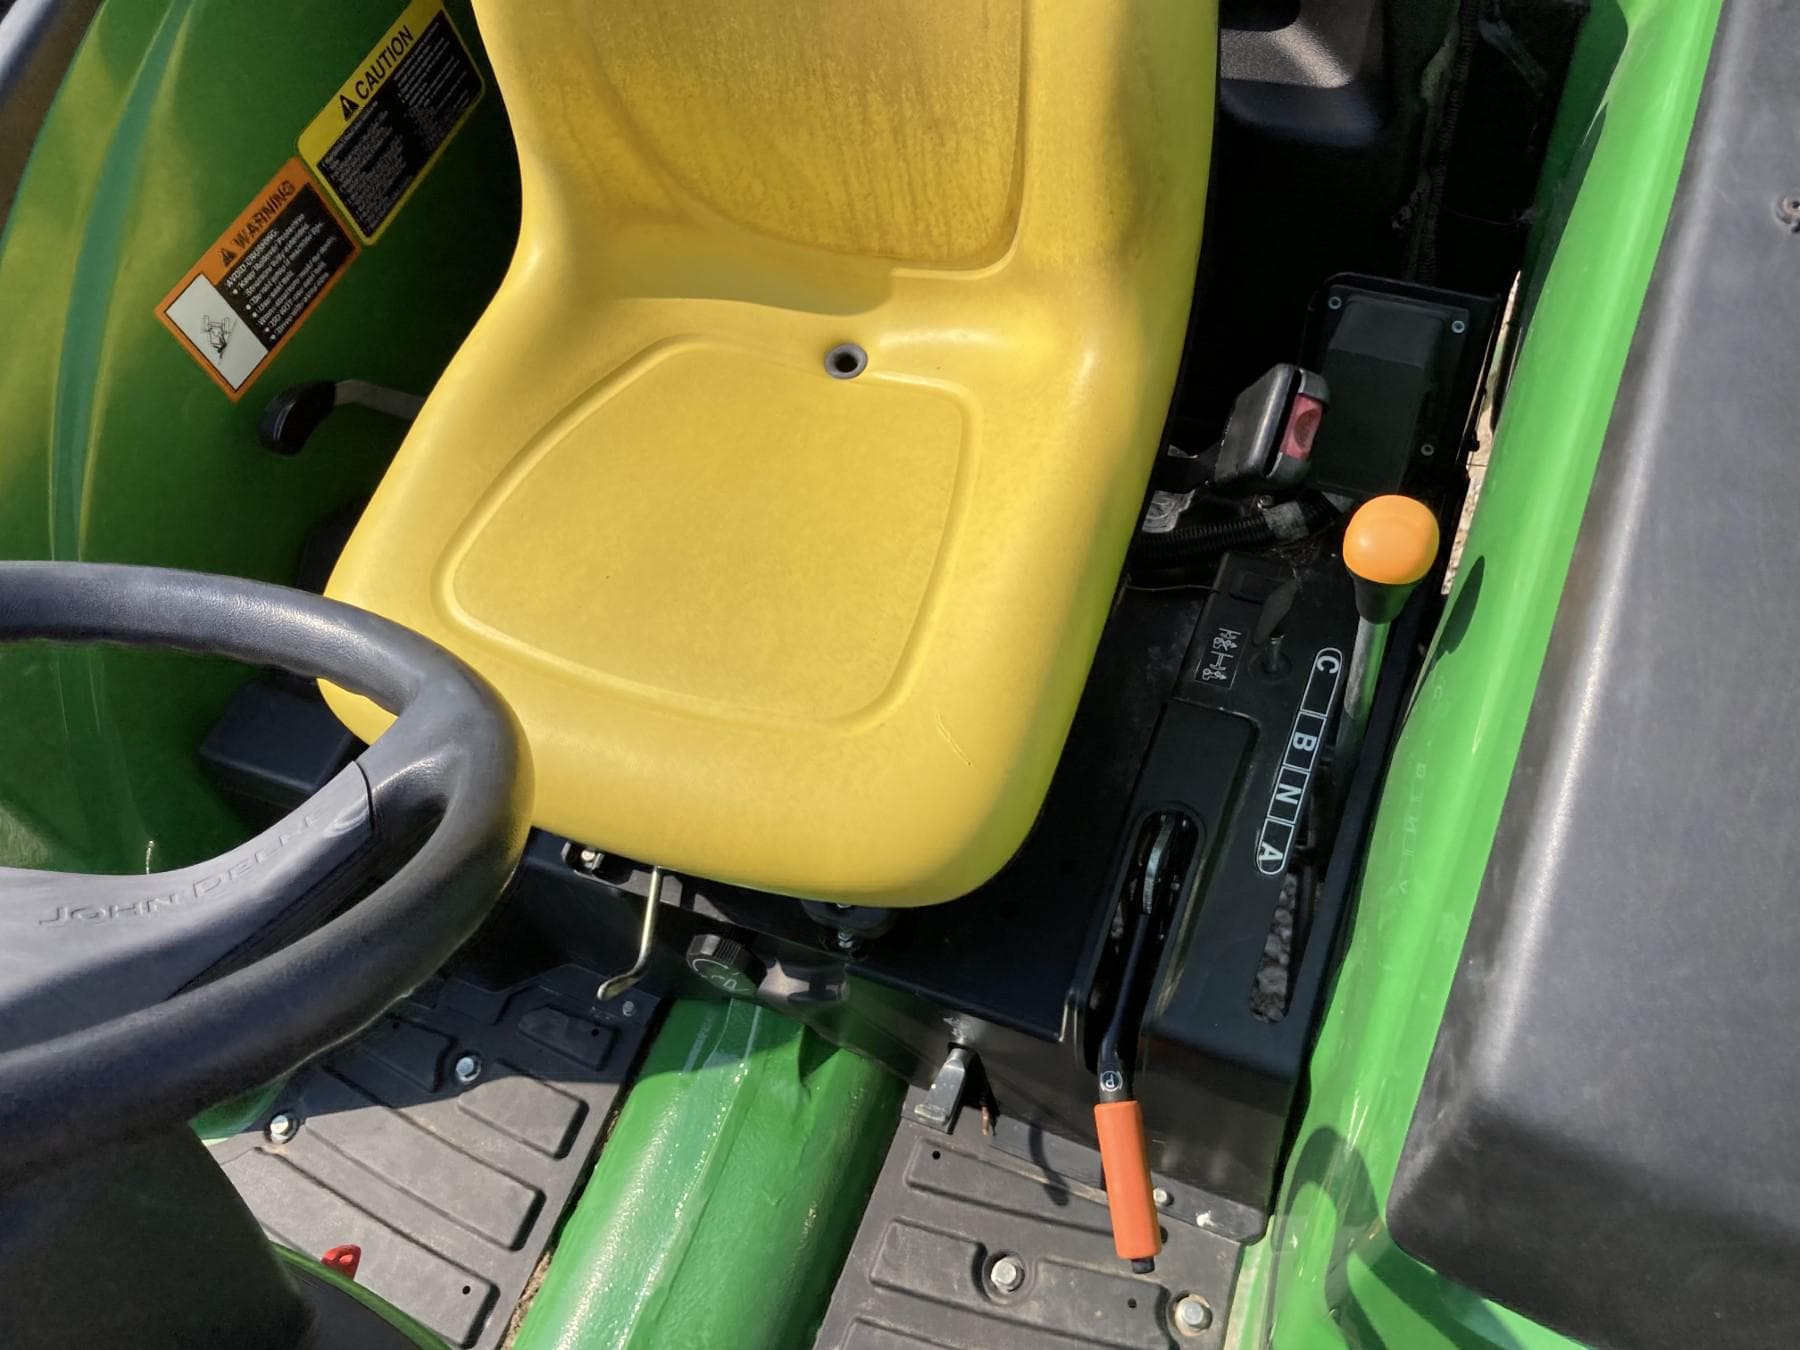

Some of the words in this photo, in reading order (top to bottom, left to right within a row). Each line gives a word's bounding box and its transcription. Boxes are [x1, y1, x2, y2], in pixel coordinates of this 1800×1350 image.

[354, 25, 414, 101] CAUTION
[233, 179, 295, 250] WARNING
[1316, 655, 1340, 675] C
[1293, 731, 1318, 752] B
[1275, 783, 1302, 806] N
[1258, 841, 1284, 861] A
[38, 893, 180, 927] JOHN
